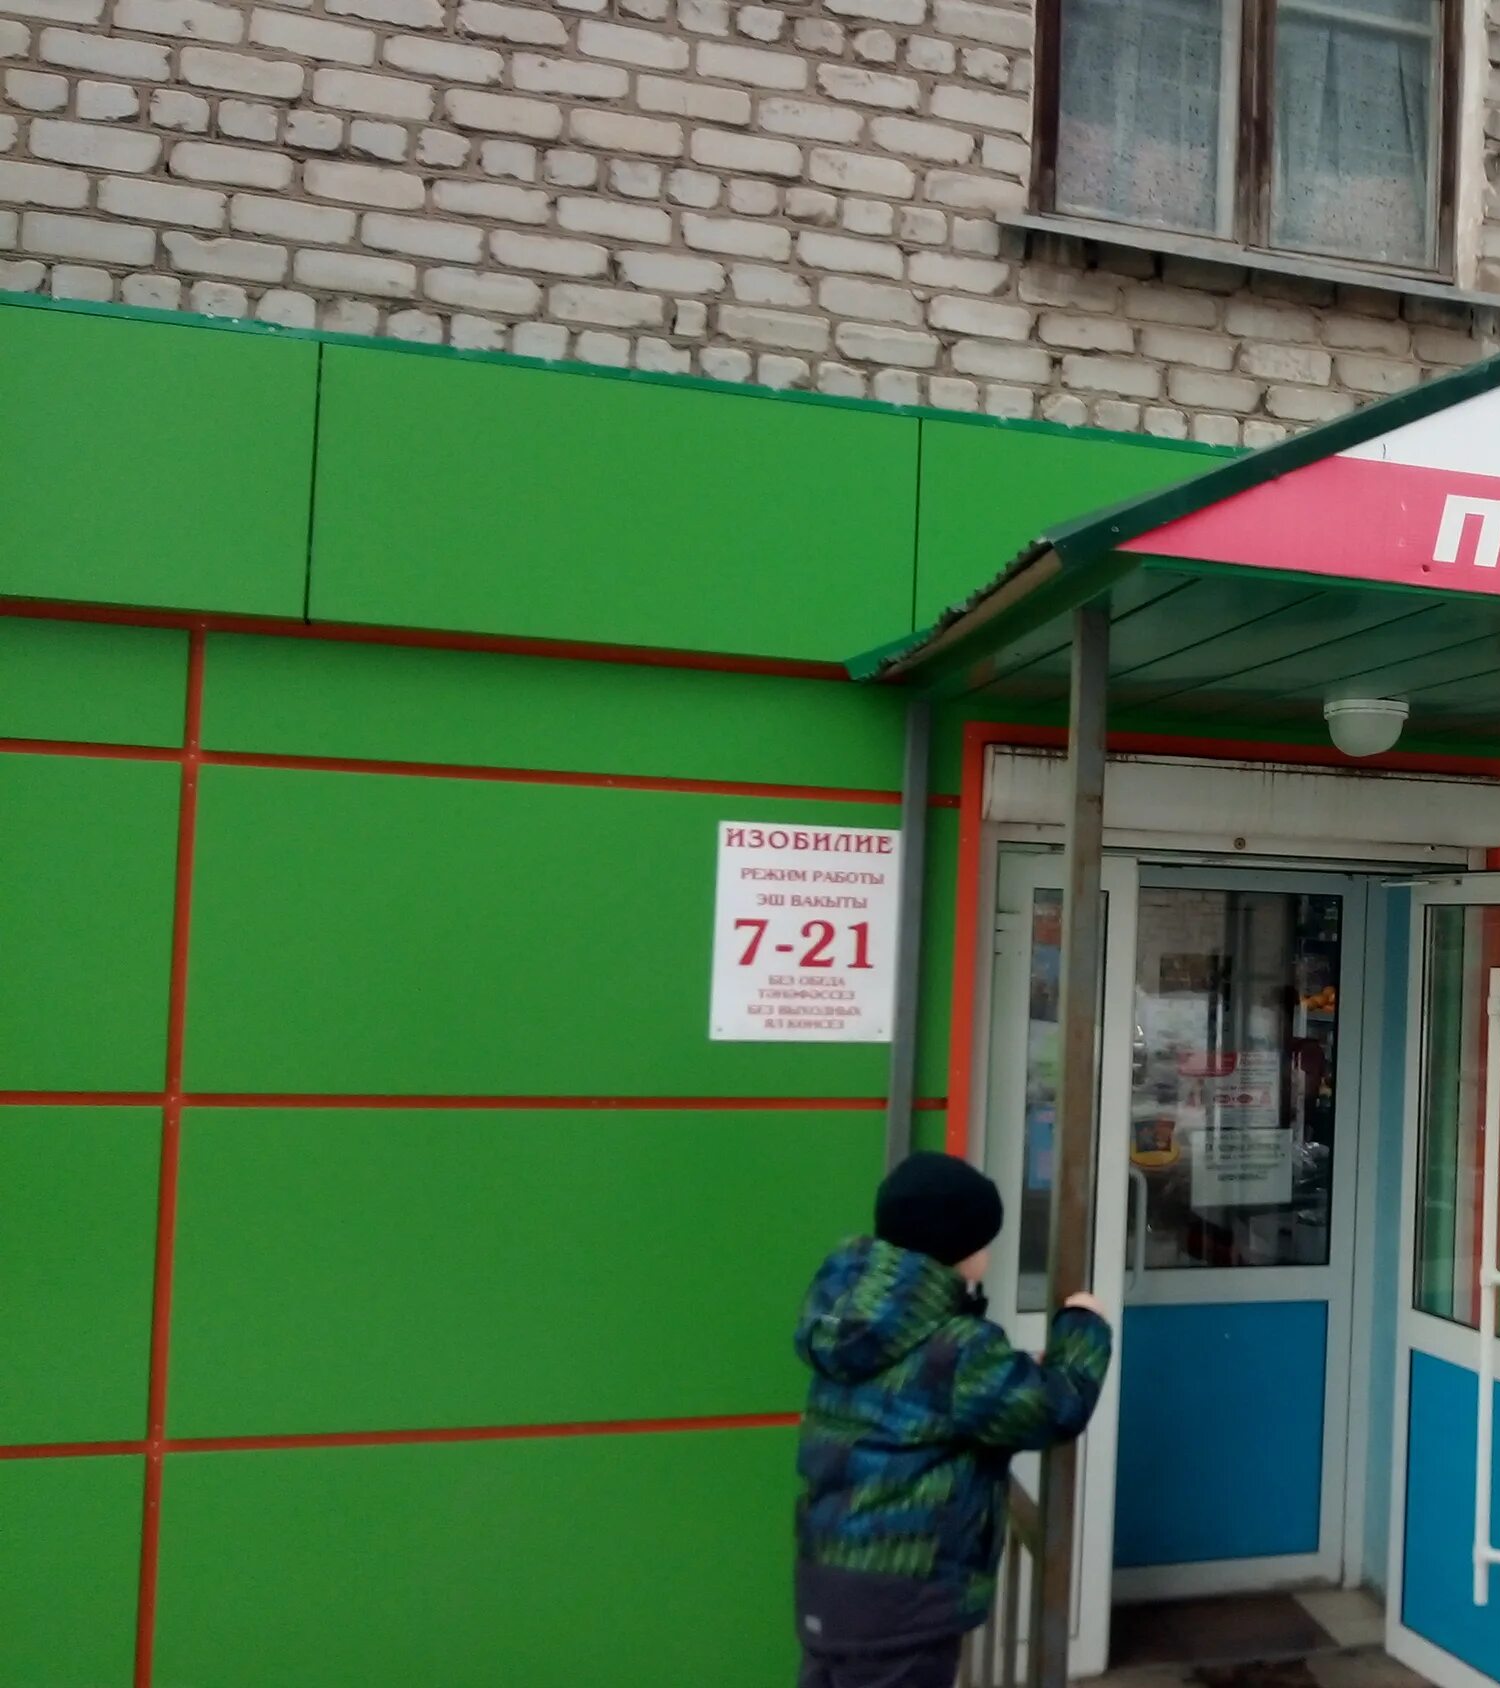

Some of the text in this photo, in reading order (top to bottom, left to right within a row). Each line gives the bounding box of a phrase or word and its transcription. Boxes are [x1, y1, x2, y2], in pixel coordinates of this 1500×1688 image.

[725, 828, 894, 855] ИЗОБИЛИЕ
[740, 867, 885, 885] РЕЖИМ РАБОТЫ
[756, 893, 868, 909] ЭШ ВАКЫТЫ
[734, 917, 874, 969] 7-21
